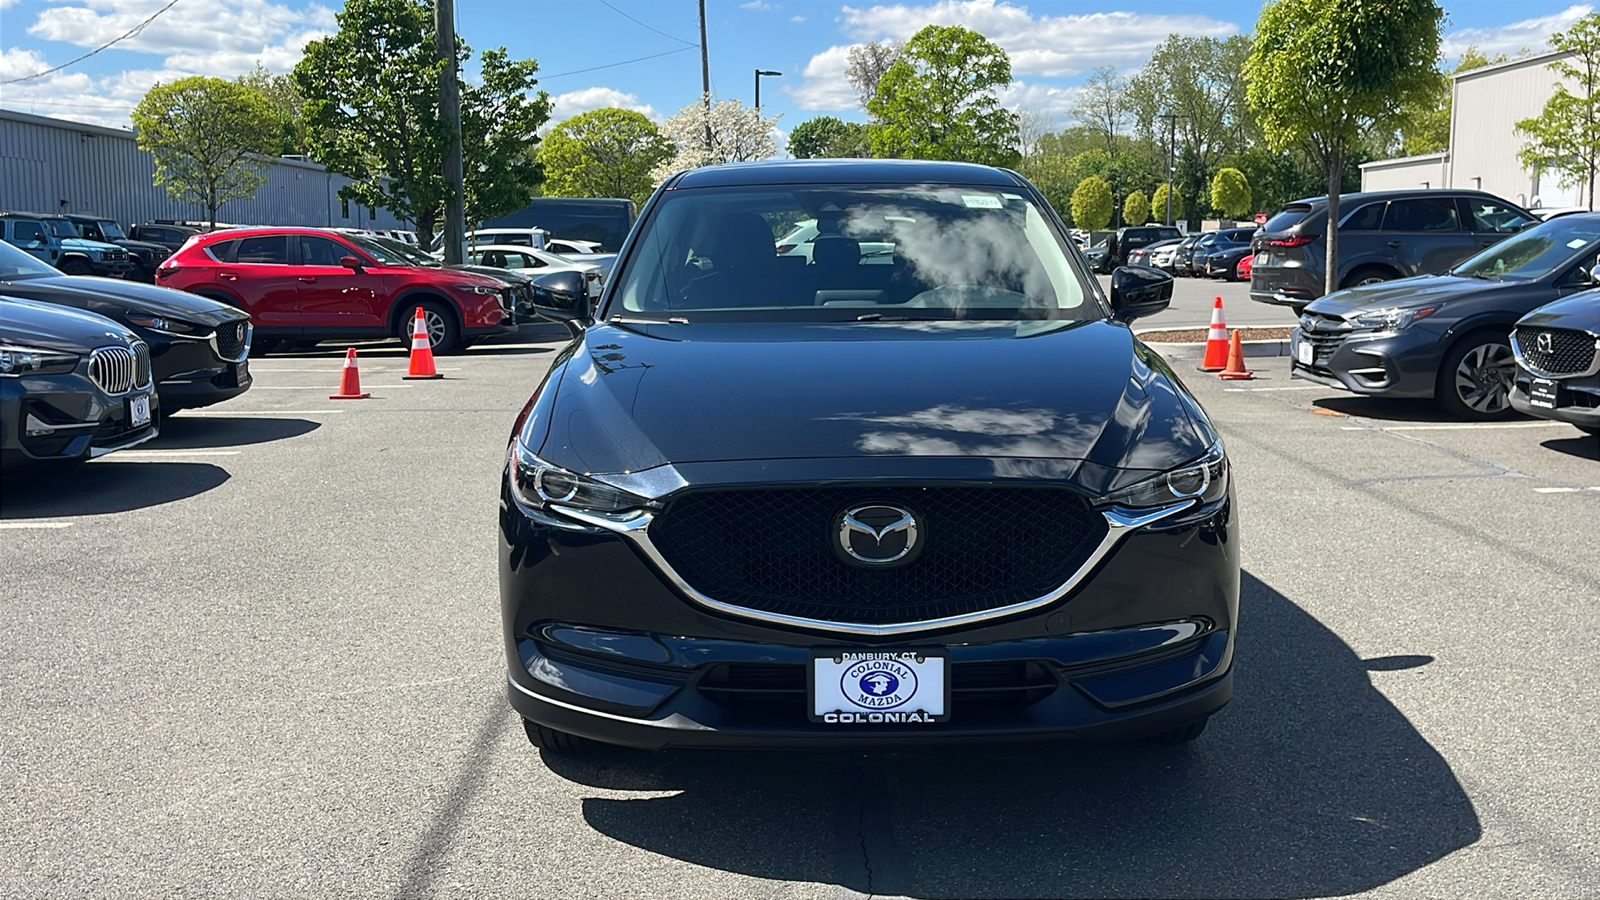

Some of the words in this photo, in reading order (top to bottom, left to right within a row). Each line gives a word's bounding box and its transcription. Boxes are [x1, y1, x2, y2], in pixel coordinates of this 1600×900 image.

[901, 651, 917, 660] CT
[851, 661, 908, 680] COLONIAL
[858, 693, 902, 706] MAZDA
[824, 713, 935, 723] COLONIAL
